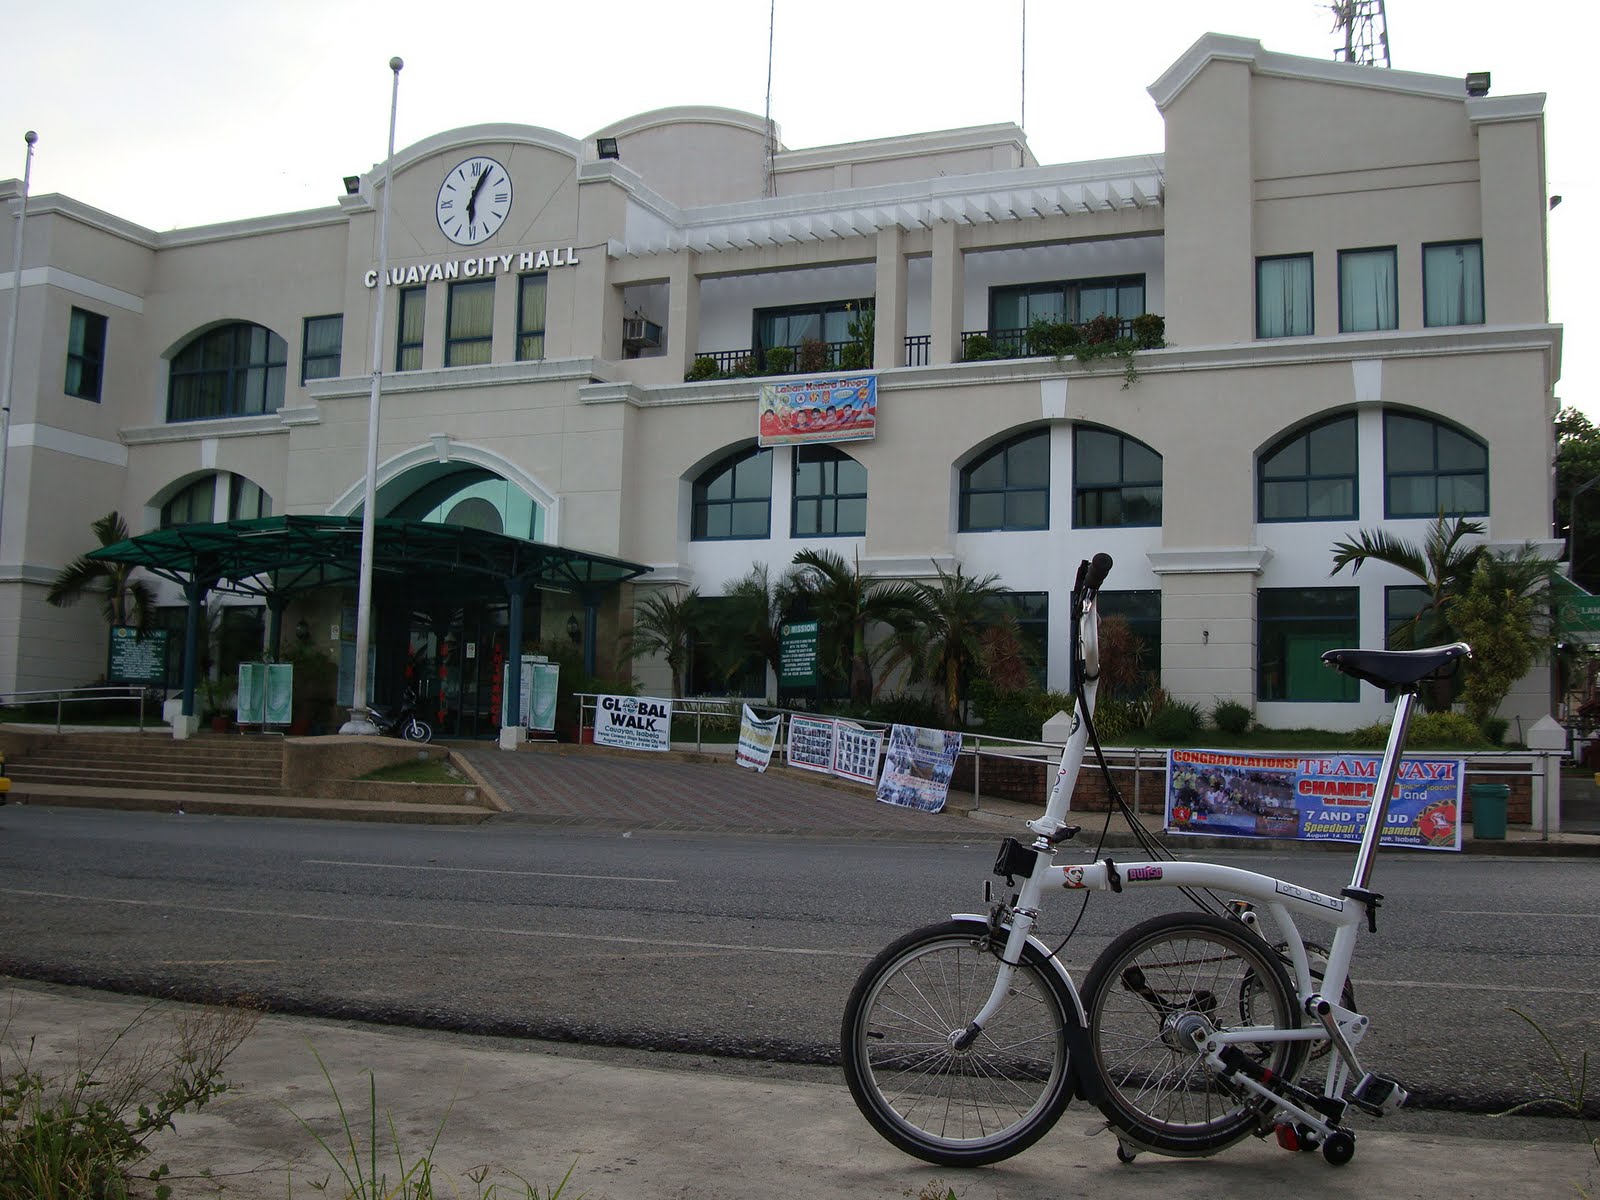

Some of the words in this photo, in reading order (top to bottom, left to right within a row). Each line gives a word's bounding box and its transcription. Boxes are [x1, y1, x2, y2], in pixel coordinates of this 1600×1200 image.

[463, 254, 514, 277] CITY
[519, 247, 579, 270] HALL
[790, 623, 816, 633] MISSION
[610, 713, 658, 732] WALK
[604, 725, 635, 736] Cauayan,
[636, 730, 659, 739] Isabela
[1173, 751, 1299, 769] CONGRATULATIONS!
[1299, 759, 1377, 778] TEAM
[1298, 780, 1400, 799] CHAMPI
[1404, 790, 1427, 800] and
[1306, 810, 1315, 820] 7
[1320, 811, 1351, 822] AND
[1356, 813, 1409, 824] PUD
[1304, 822, 1355, 833] Speedball
[1359, 825, 1421, 836] Tnament
